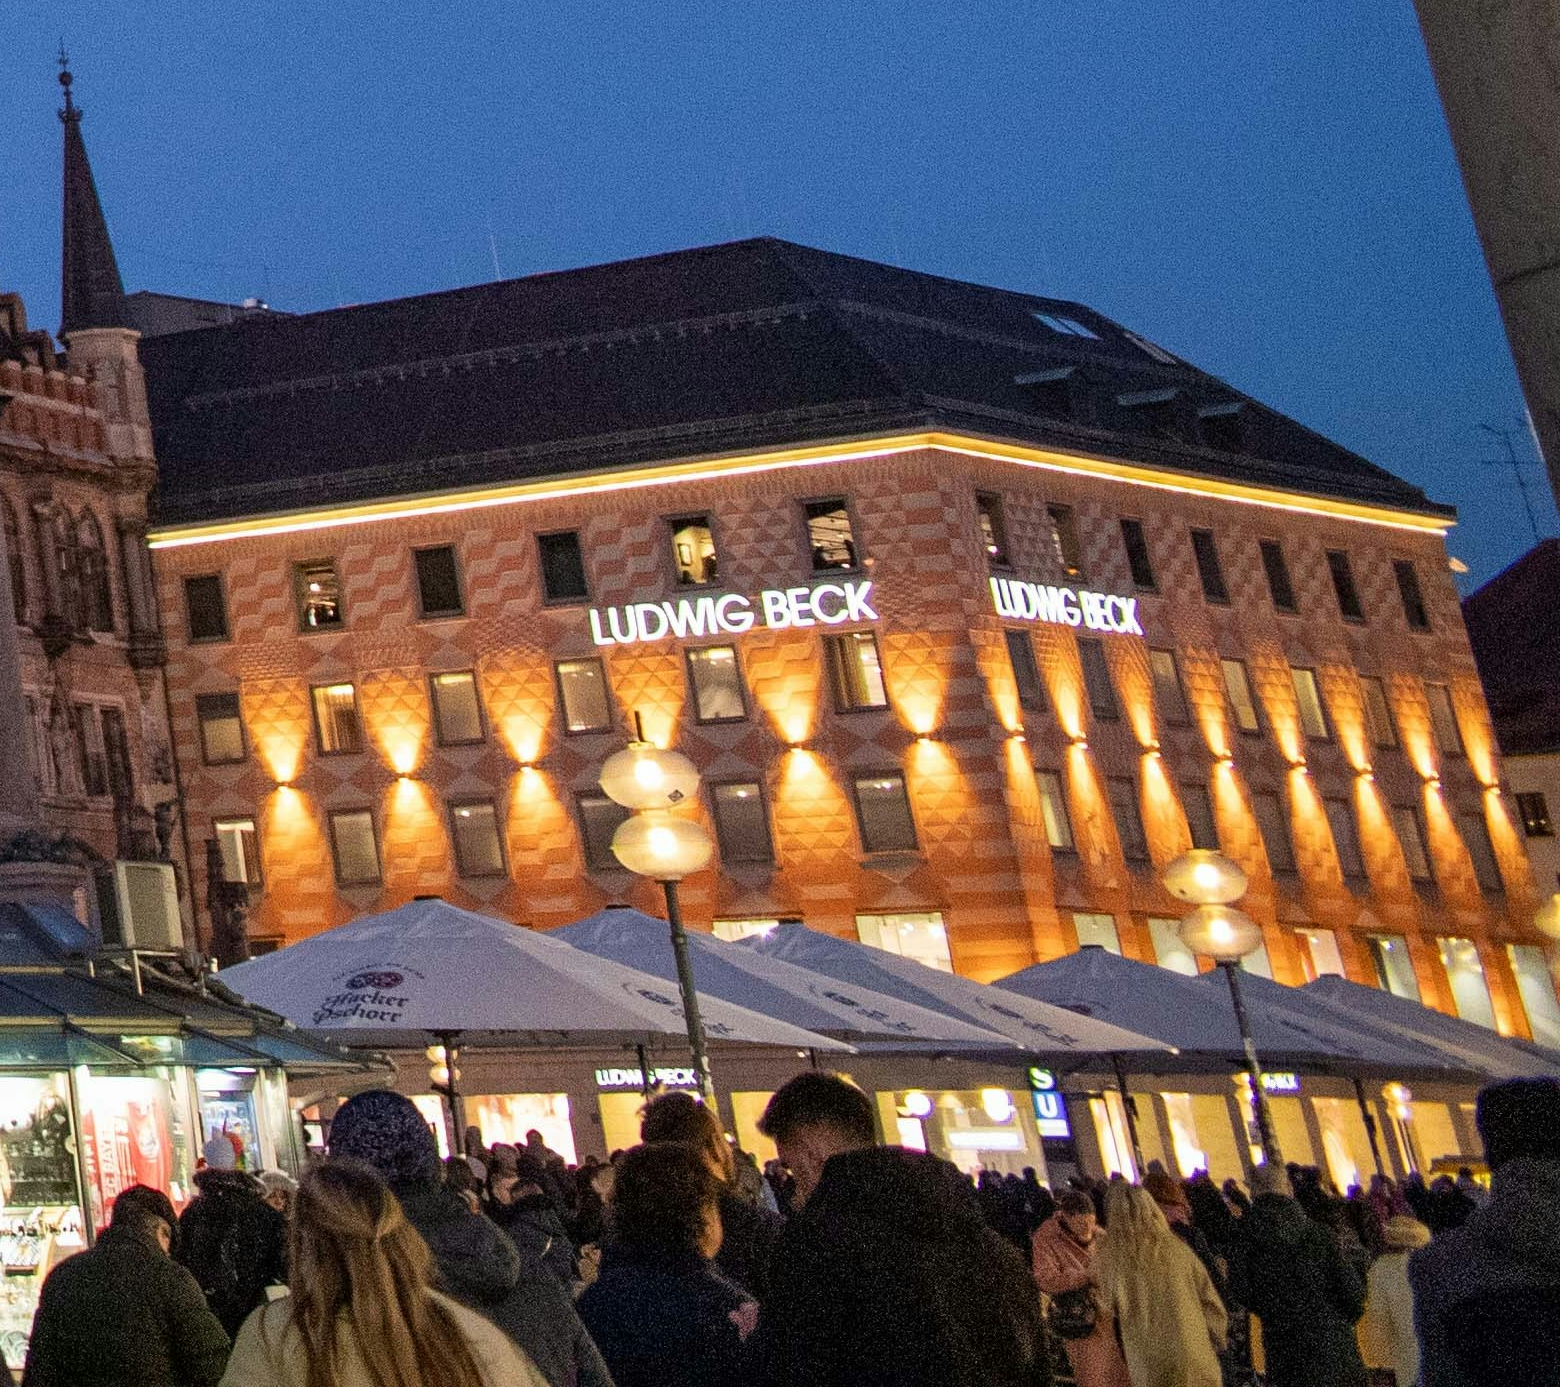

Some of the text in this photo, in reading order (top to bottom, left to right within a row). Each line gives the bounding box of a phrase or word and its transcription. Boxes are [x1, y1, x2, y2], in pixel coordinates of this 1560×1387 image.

[589, 581, 879, 645] LUDWIG BECK
[989, 577, 1145, 636] LUDWIG BECK
[1029, 1067, 1056, 1090] S
[1035, 1093, 1059, 1119] U
